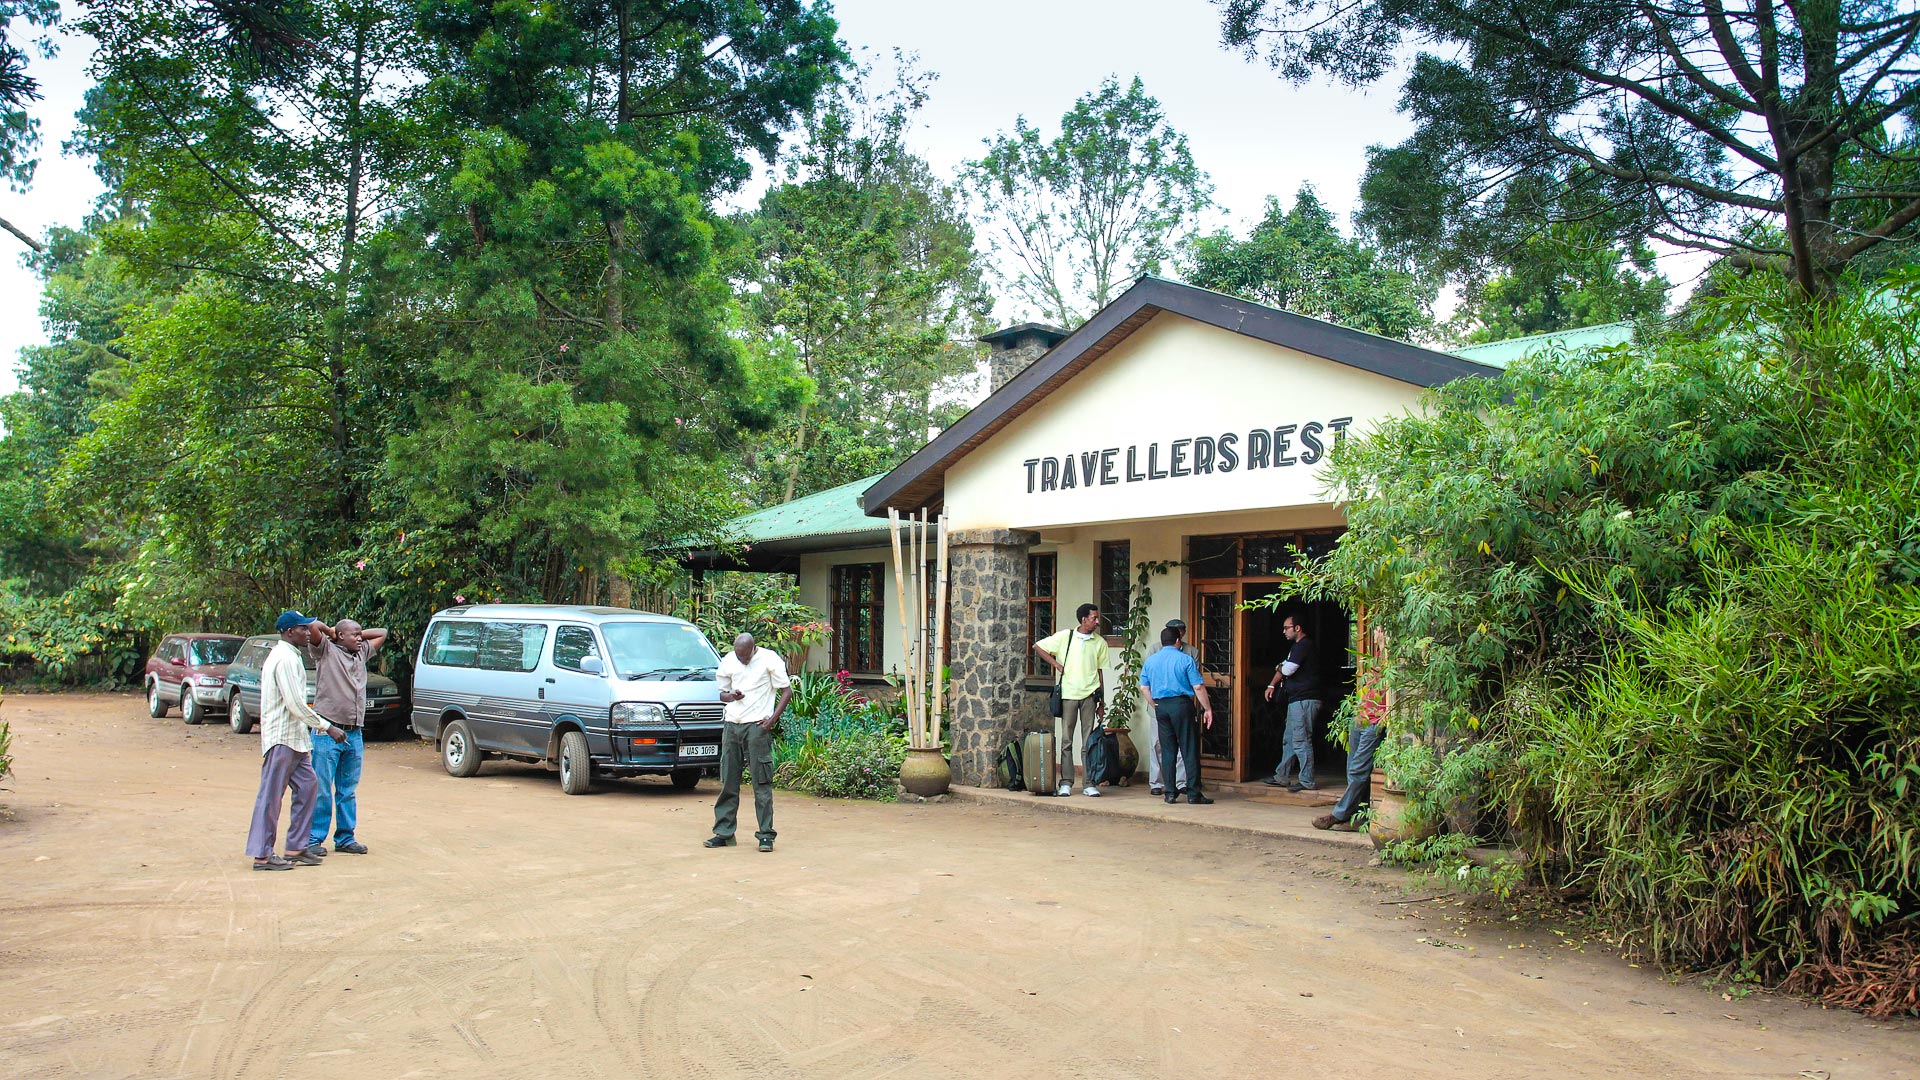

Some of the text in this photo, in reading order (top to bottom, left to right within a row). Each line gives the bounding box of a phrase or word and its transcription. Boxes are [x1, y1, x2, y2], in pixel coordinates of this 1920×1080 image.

[1024, 417, 1353, 493] TRAVELLERS REST
[686, 746, 699, 755] UAS
